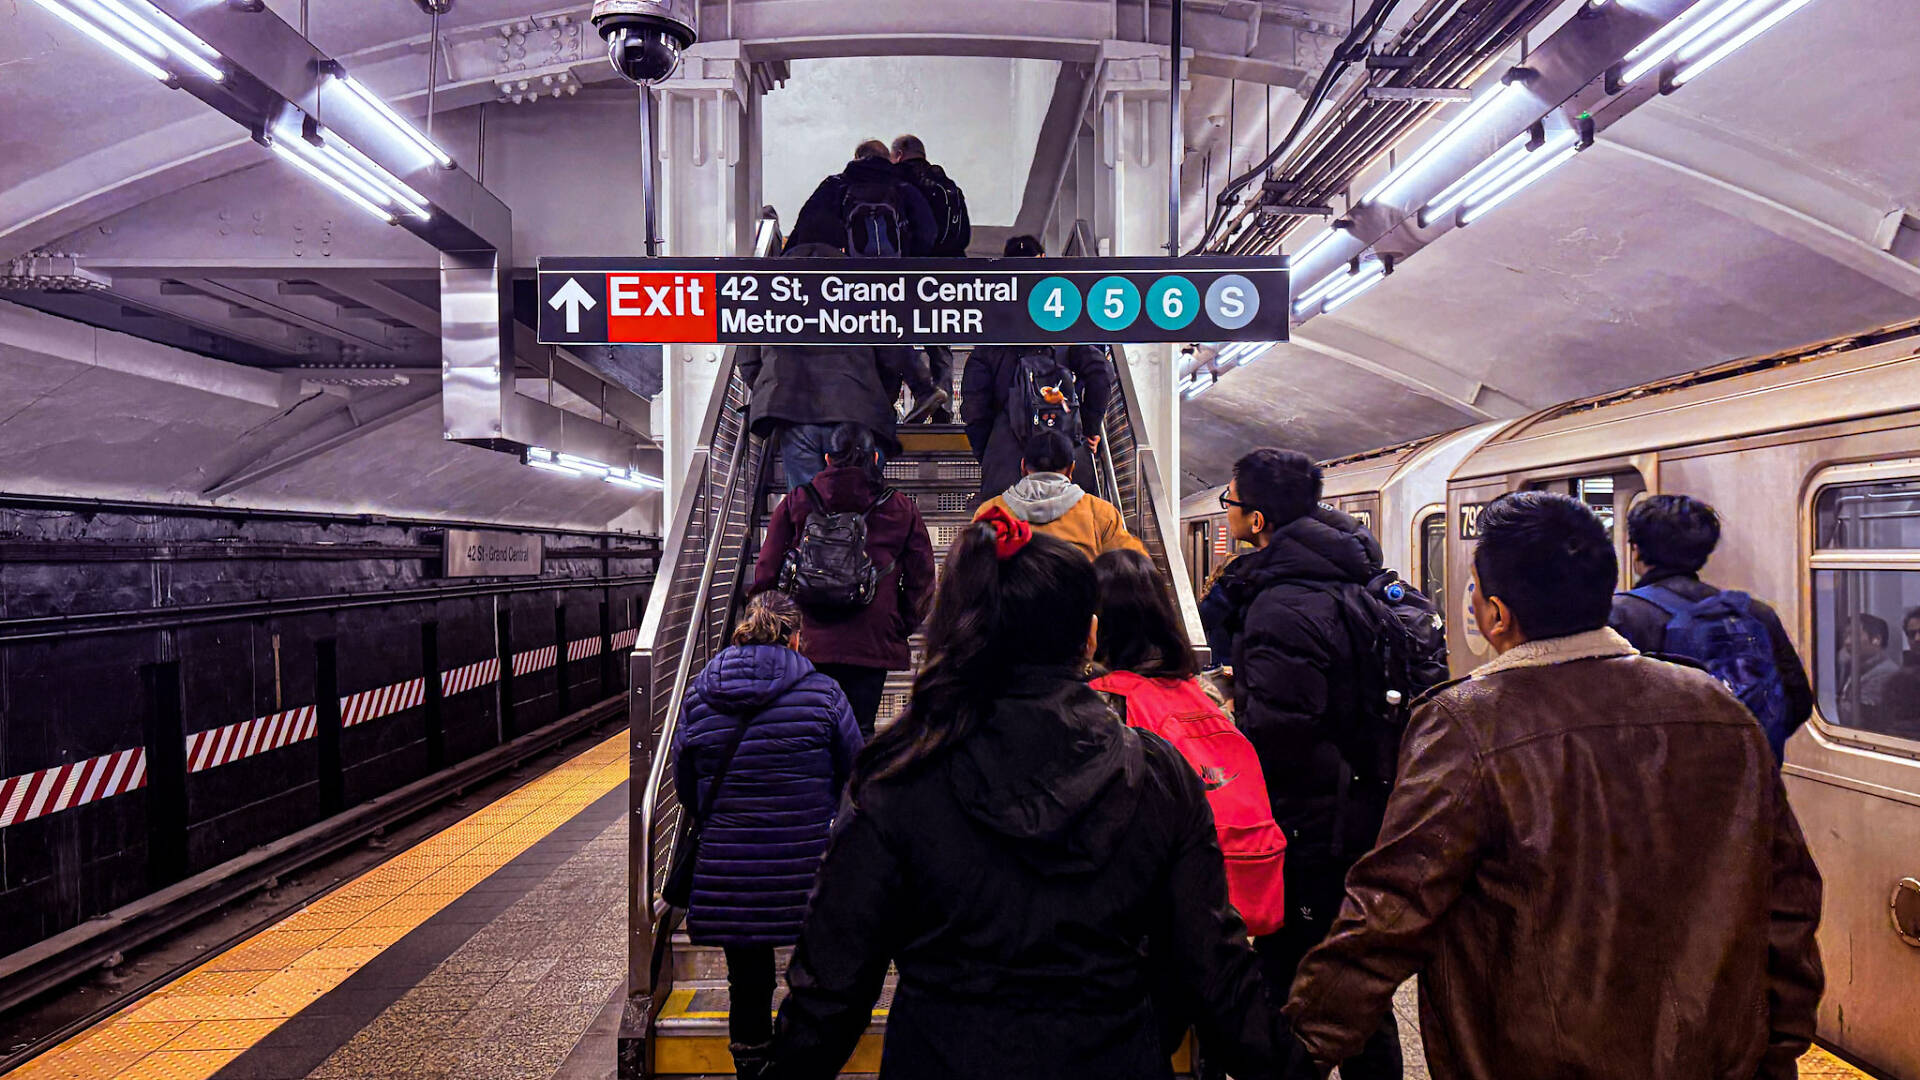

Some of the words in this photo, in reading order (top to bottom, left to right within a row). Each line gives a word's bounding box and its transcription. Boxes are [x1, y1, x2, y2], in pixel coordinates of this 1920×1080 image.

[610, 276, 704, 316] Exit
[721, 276, 758, 301] 42
[770, 276, 809, 306] St,
[821, 276, 905, 302] Grand
[917, 276, 1017, 302] Central
[1043, 288, 1065, 318] 4
[1103, 288, 1124, 319] 5
[1162, 287, 1183, 318] 6
[1219, 286, 1245, 318] S
[721, 308, 904, 338] Metro-North,
[913, 309, 983, 333] LIRR
[467, 545, 476, 561] 42
[508, 546, 529, 562] Central
